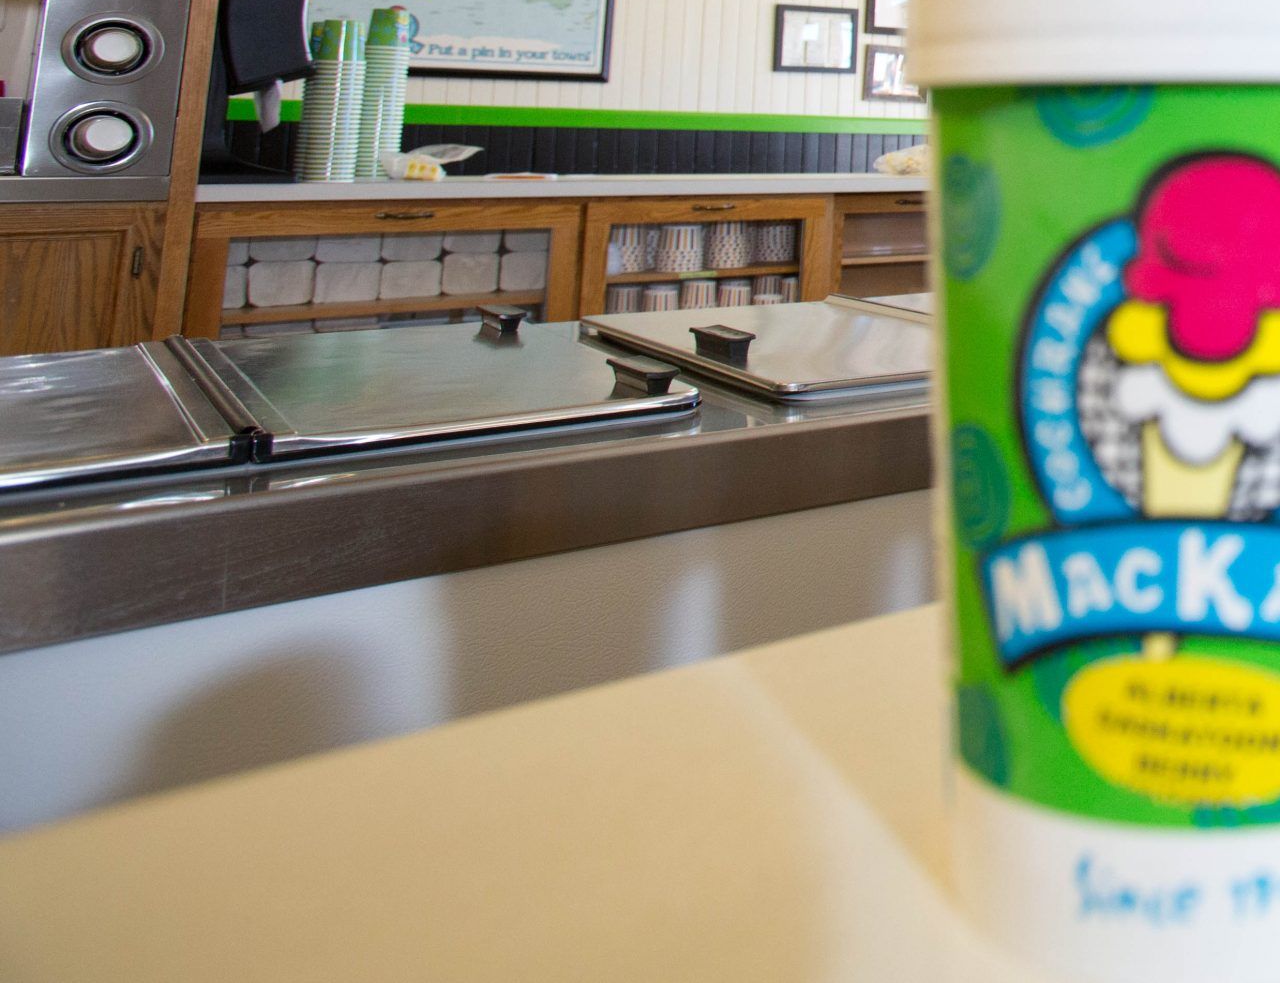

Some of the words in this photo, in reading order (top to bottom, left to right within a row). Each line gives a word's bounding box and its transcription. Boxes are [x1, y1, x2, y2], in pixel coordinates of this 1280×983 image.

[428, 43, 453, 56] Put
[458, 47, 467, 56] a
[471, 47, 494, 59] pin
[516, 49, 548, 61] your
